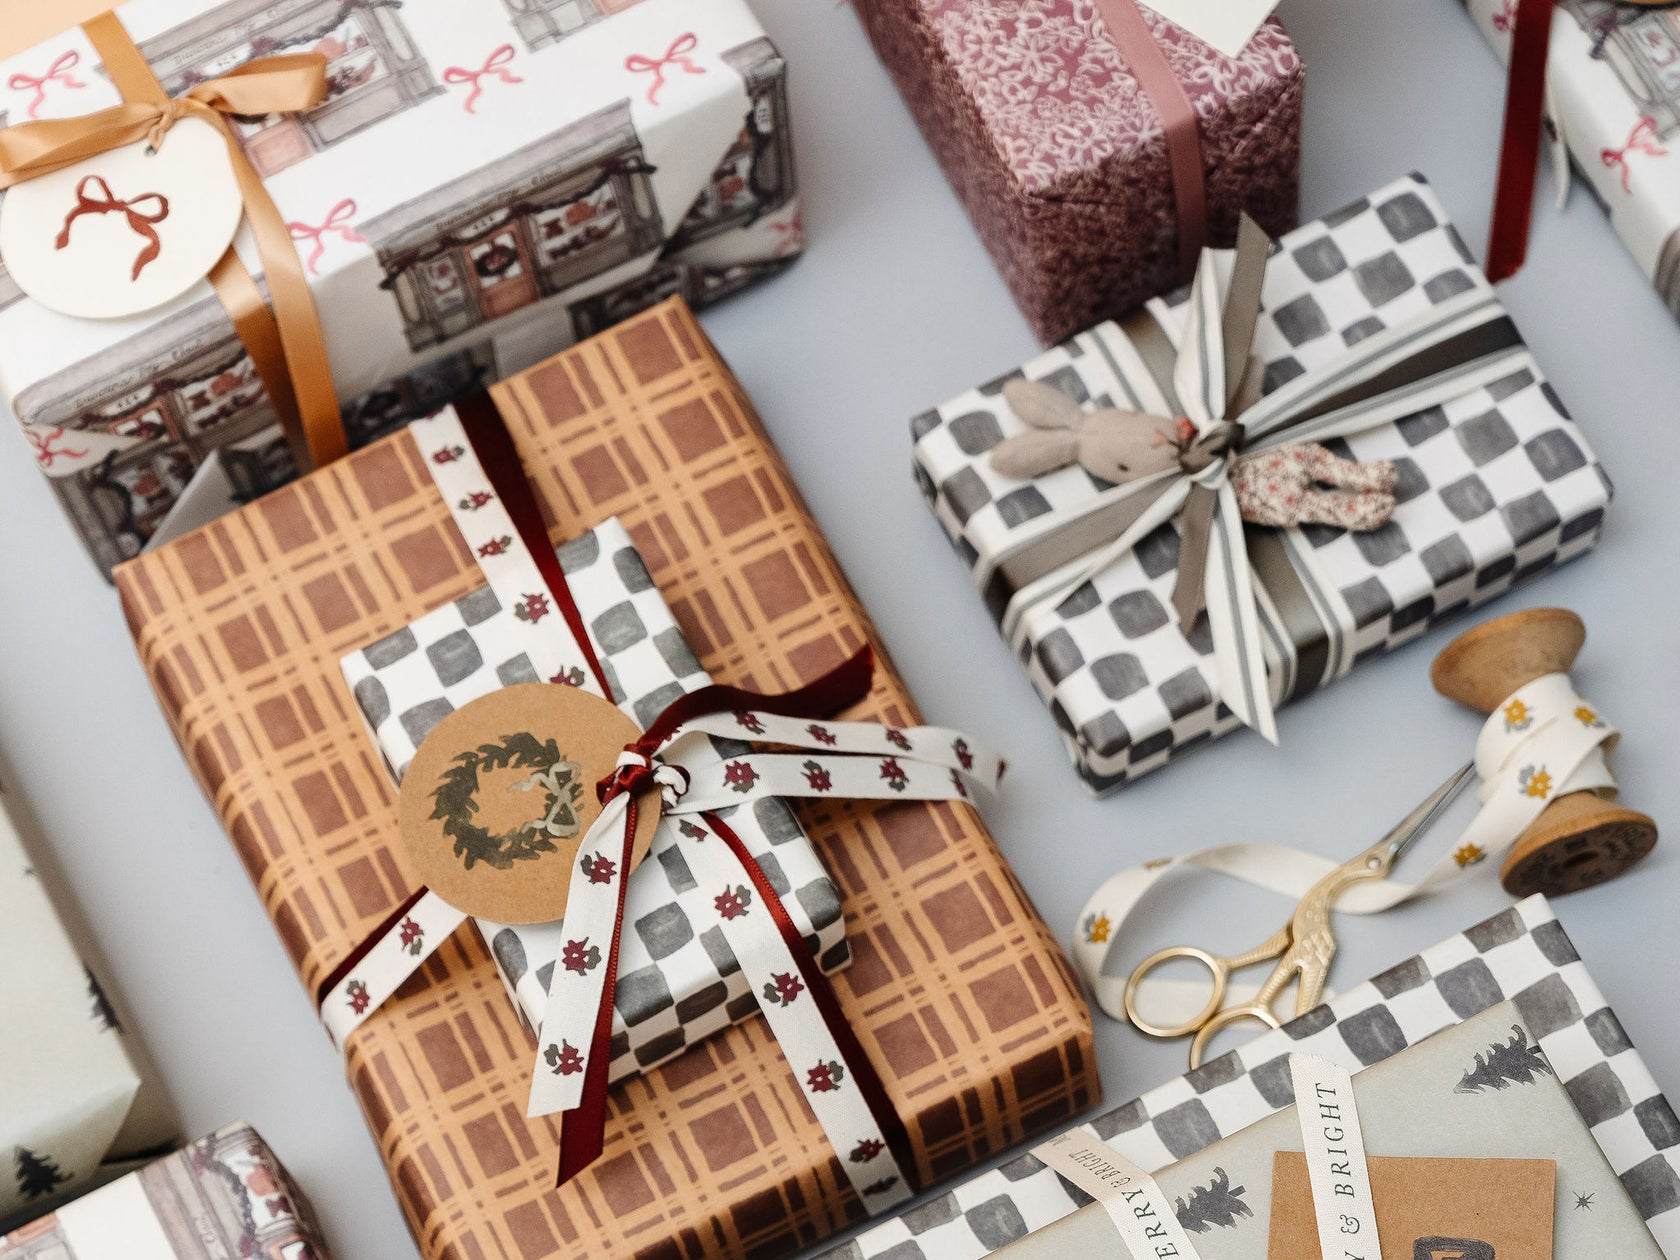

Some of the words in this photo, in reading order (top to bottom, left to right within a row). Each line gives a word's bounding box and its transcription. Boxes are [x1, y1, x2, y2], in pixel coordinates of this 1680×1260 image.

[1315, 1082, 1355, 1198] BRIGHT
[1068, 1148, 1121, 1182] BRIGHT
[1340, 1214, 1360, 1235] &
